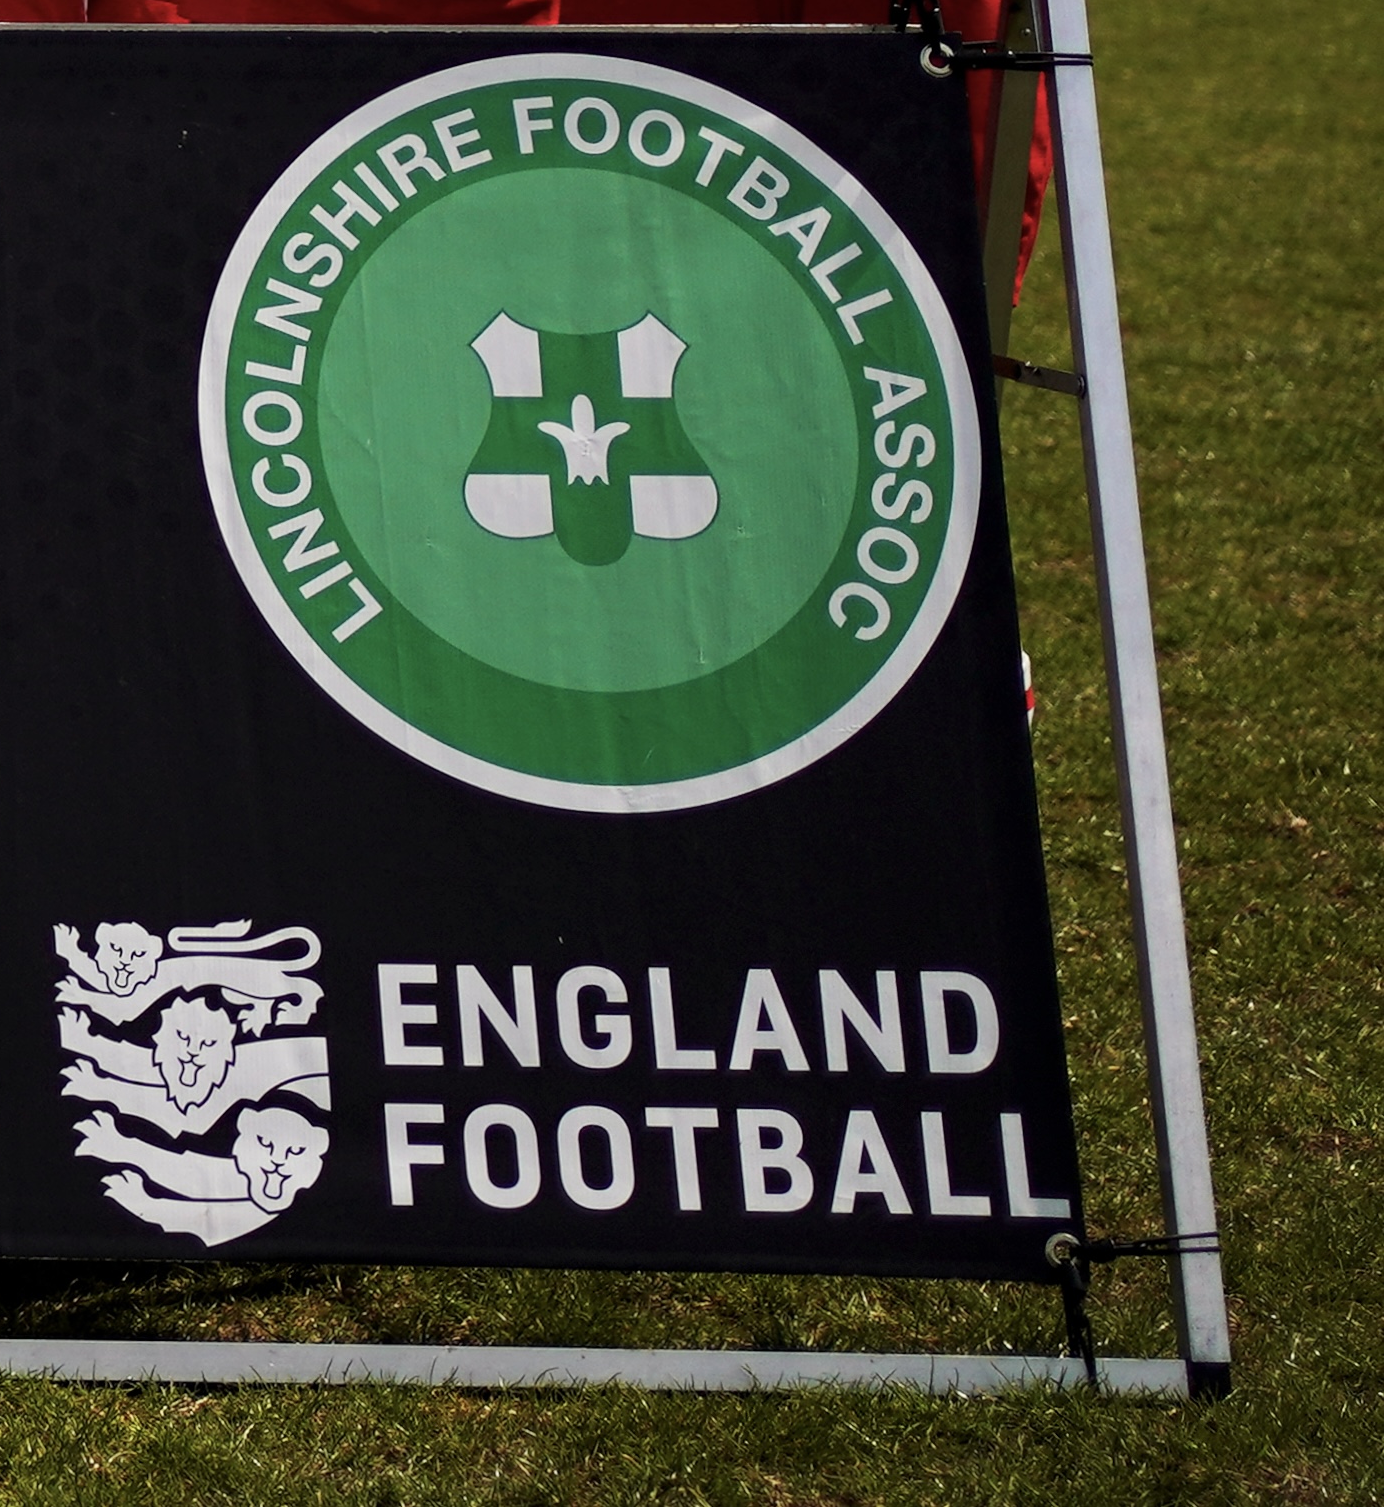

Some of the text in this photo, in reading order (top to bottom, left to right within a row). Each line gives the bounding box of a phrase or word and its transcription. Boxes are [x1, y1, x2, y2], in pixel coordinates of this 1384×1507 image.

[243, 96, 936, 643] LINCOLNSHIRE FOOTBALL ASSOC
[377, 964, 1000, 1073] ENGLAND
[384, 1104, 1071, 1218] FOOTBALL
